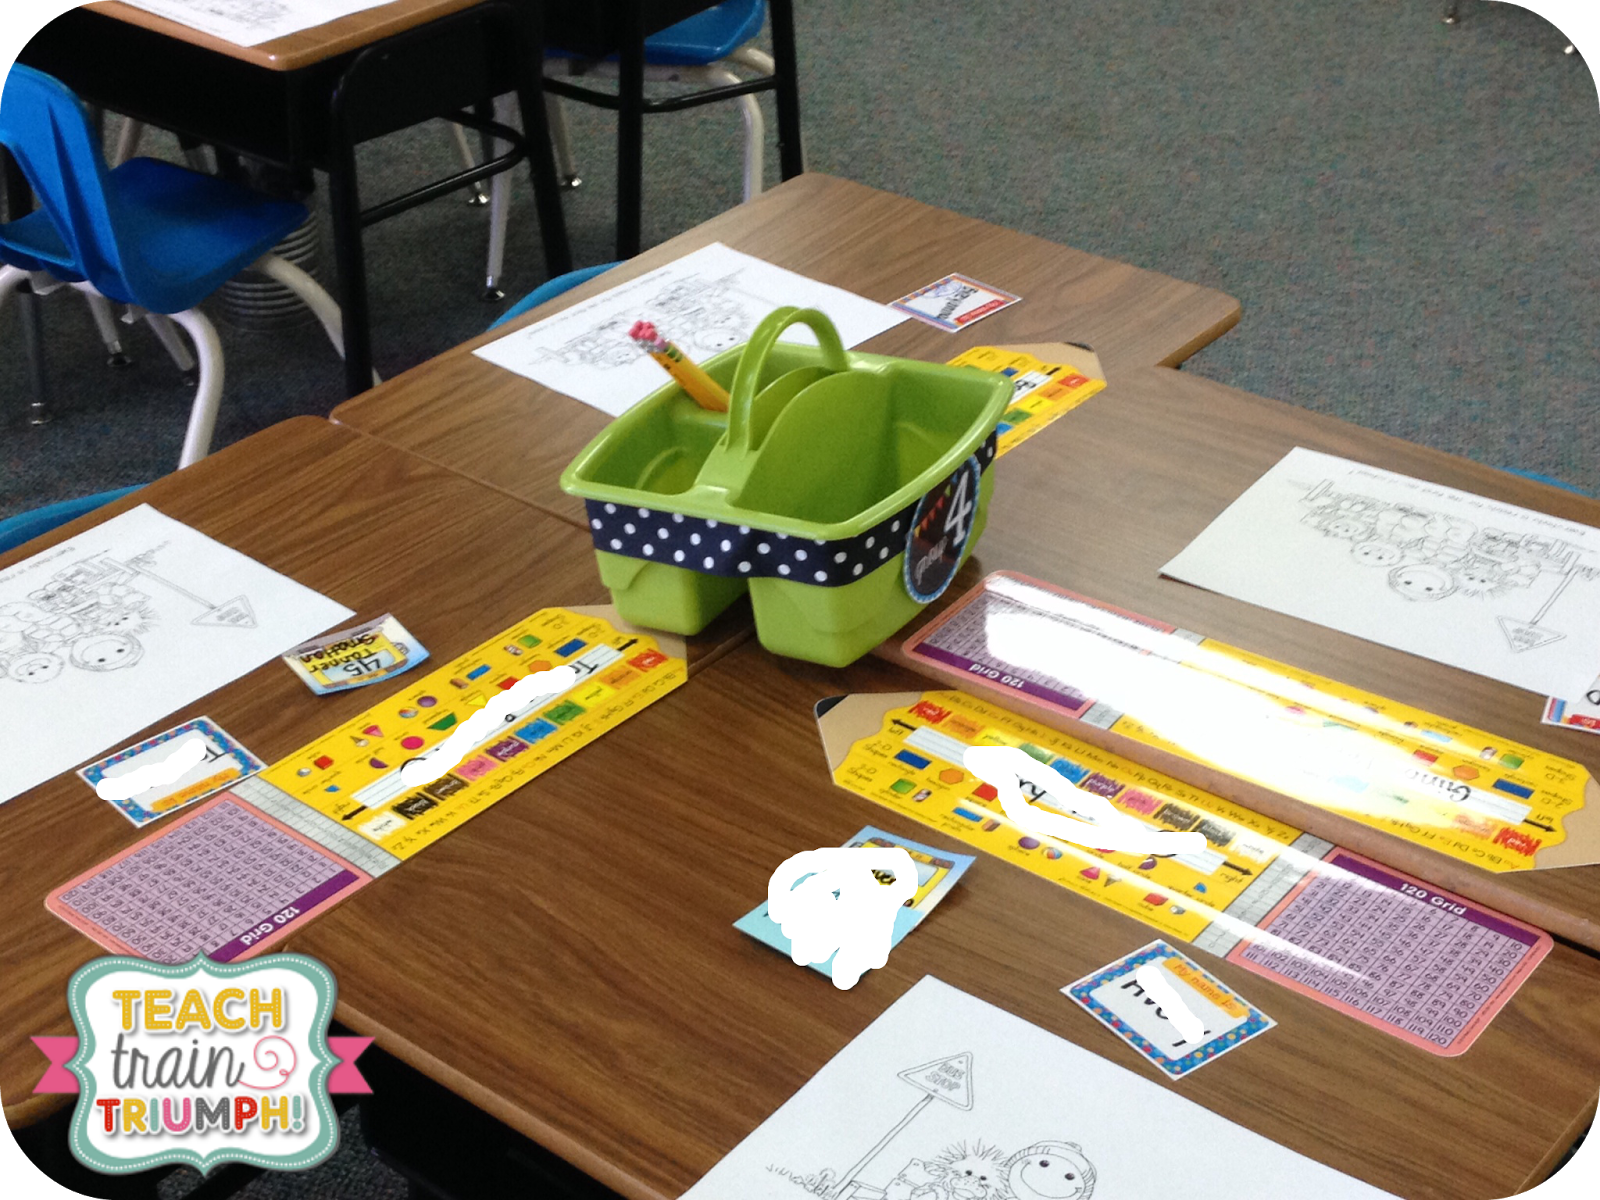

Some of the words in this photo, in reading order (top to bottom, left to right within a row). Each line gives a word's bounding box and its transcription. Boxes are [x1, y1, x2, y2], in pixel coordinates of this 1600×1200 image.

[944, 470, 972, 546] 4
[309, 648, 375, 673] Tanner
[342, 657, 382, 677] 45
[969, 663, 1000, 678] Grid
[1000, 674, 1026, 687] 120
[922, 706, 940, 716] red
[886, 726, 904, 736] left
[1085, 776, 1120, 794] purple
[1535, 812, 1553, 823] left
[1507, 837, 1526, 848] red
[1218, 871, 1243, 886] right
[1399, 883, 1428, 899] 120
[1430, 895, 1466, 915] Grid
[270, 906, 300, 923] 120
[237, 922, 275, 944] Grid
[1171, 964, 1192, 977] My
[1189, 977, 1223, 999] name
